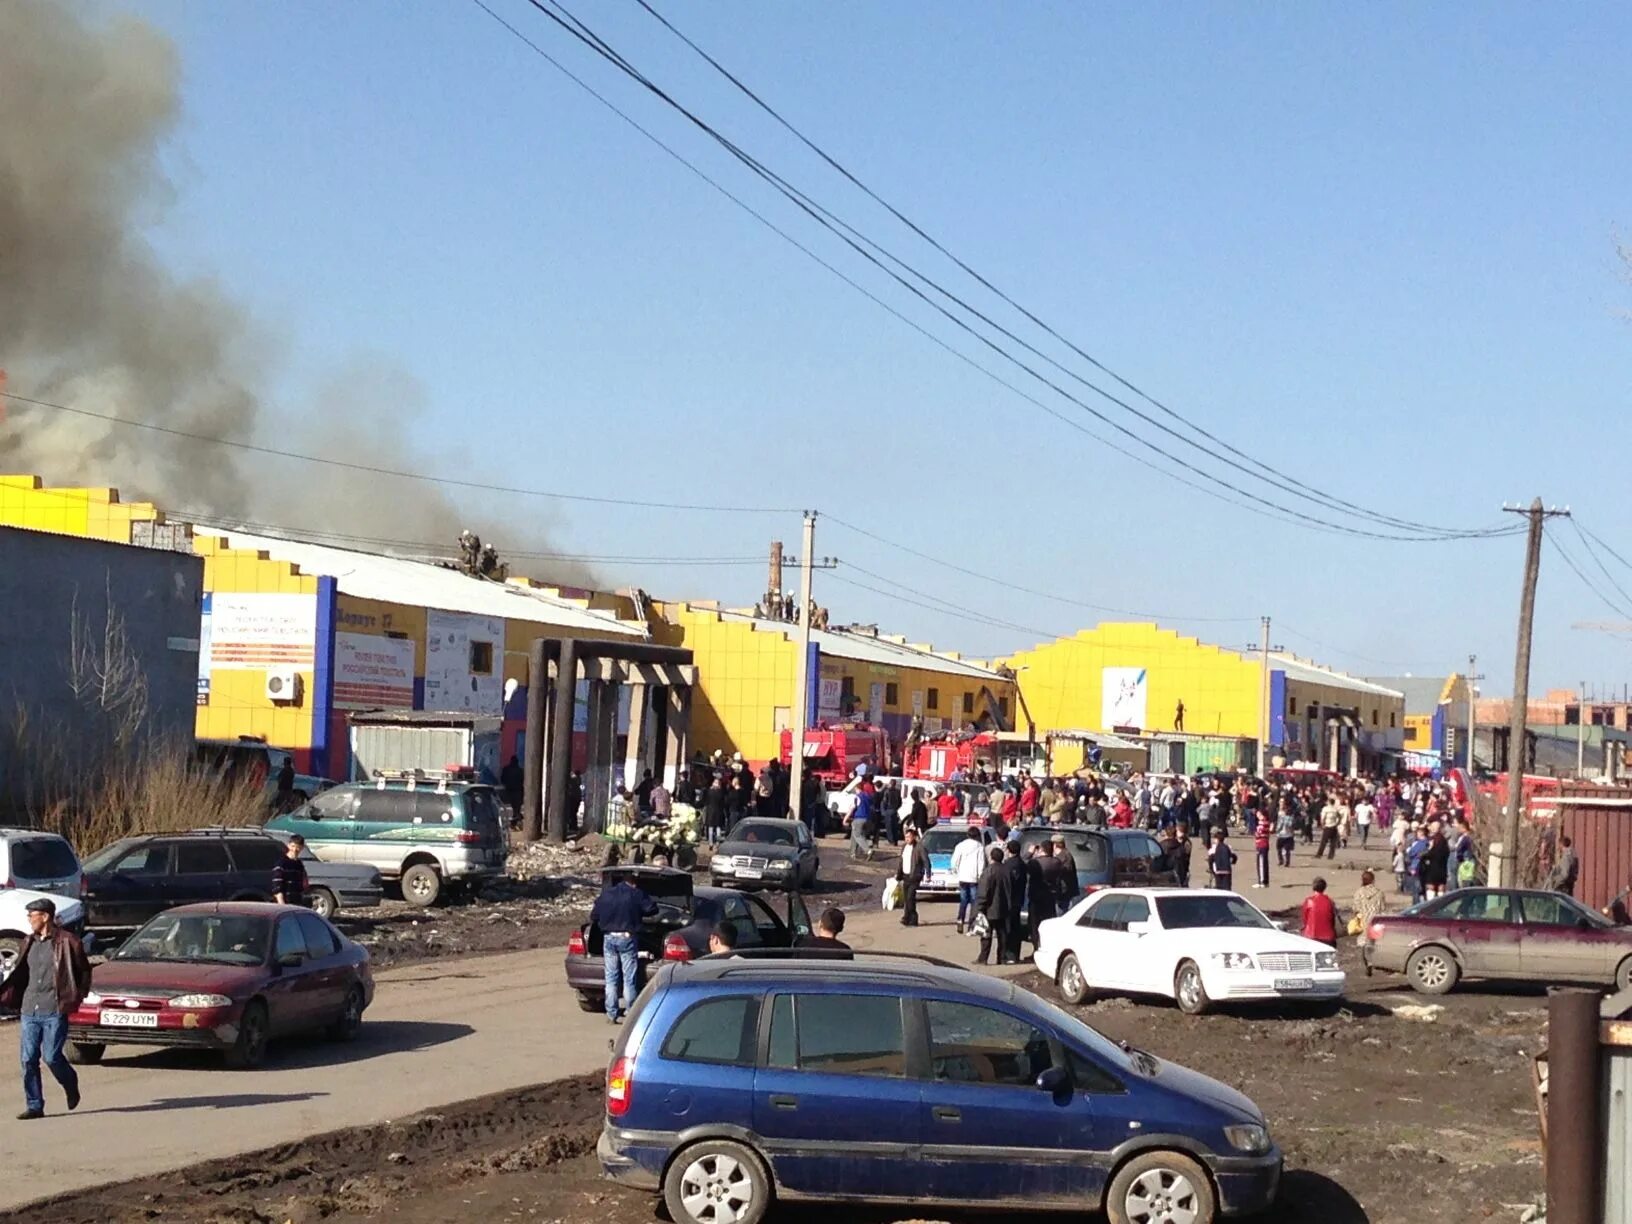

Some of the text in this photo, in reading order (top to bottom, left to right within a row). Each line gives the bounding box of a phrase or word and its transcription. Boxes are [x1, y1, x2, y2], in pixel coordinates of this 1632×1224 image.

[103, 1013, 155, 1025] S 229 UYM
